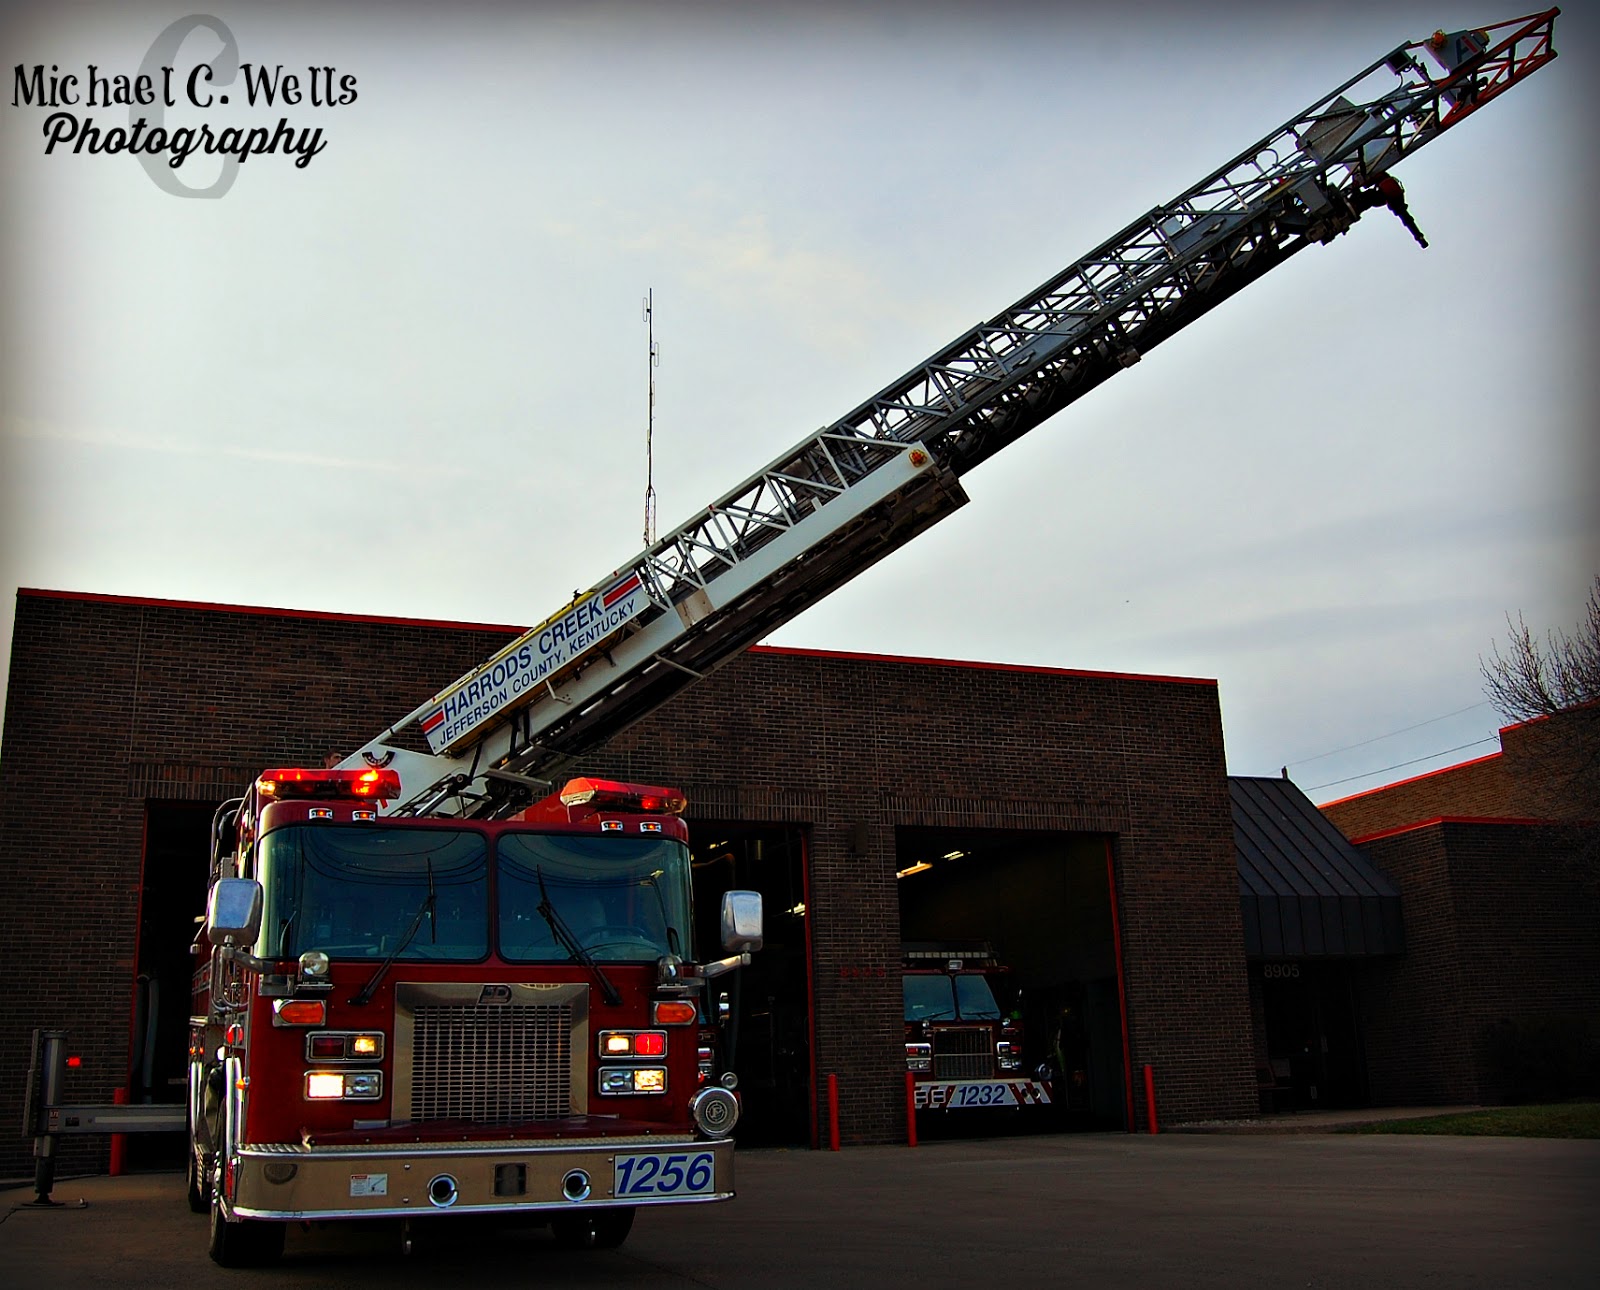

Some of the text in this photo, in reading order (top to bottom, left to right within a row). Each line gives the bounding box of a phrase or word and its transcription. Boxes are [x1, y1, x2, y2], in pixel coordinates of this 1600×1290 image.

[538, 597, 604, 655] CREEK
[439, 599, 635, 746] JEFFERSON COUNTY, KENTUCKY
[1263, 963, 1300, 978] 8905
[958, 1084, 1006, 1106] 1232
[617, 1153, 713, 1194] 1256
